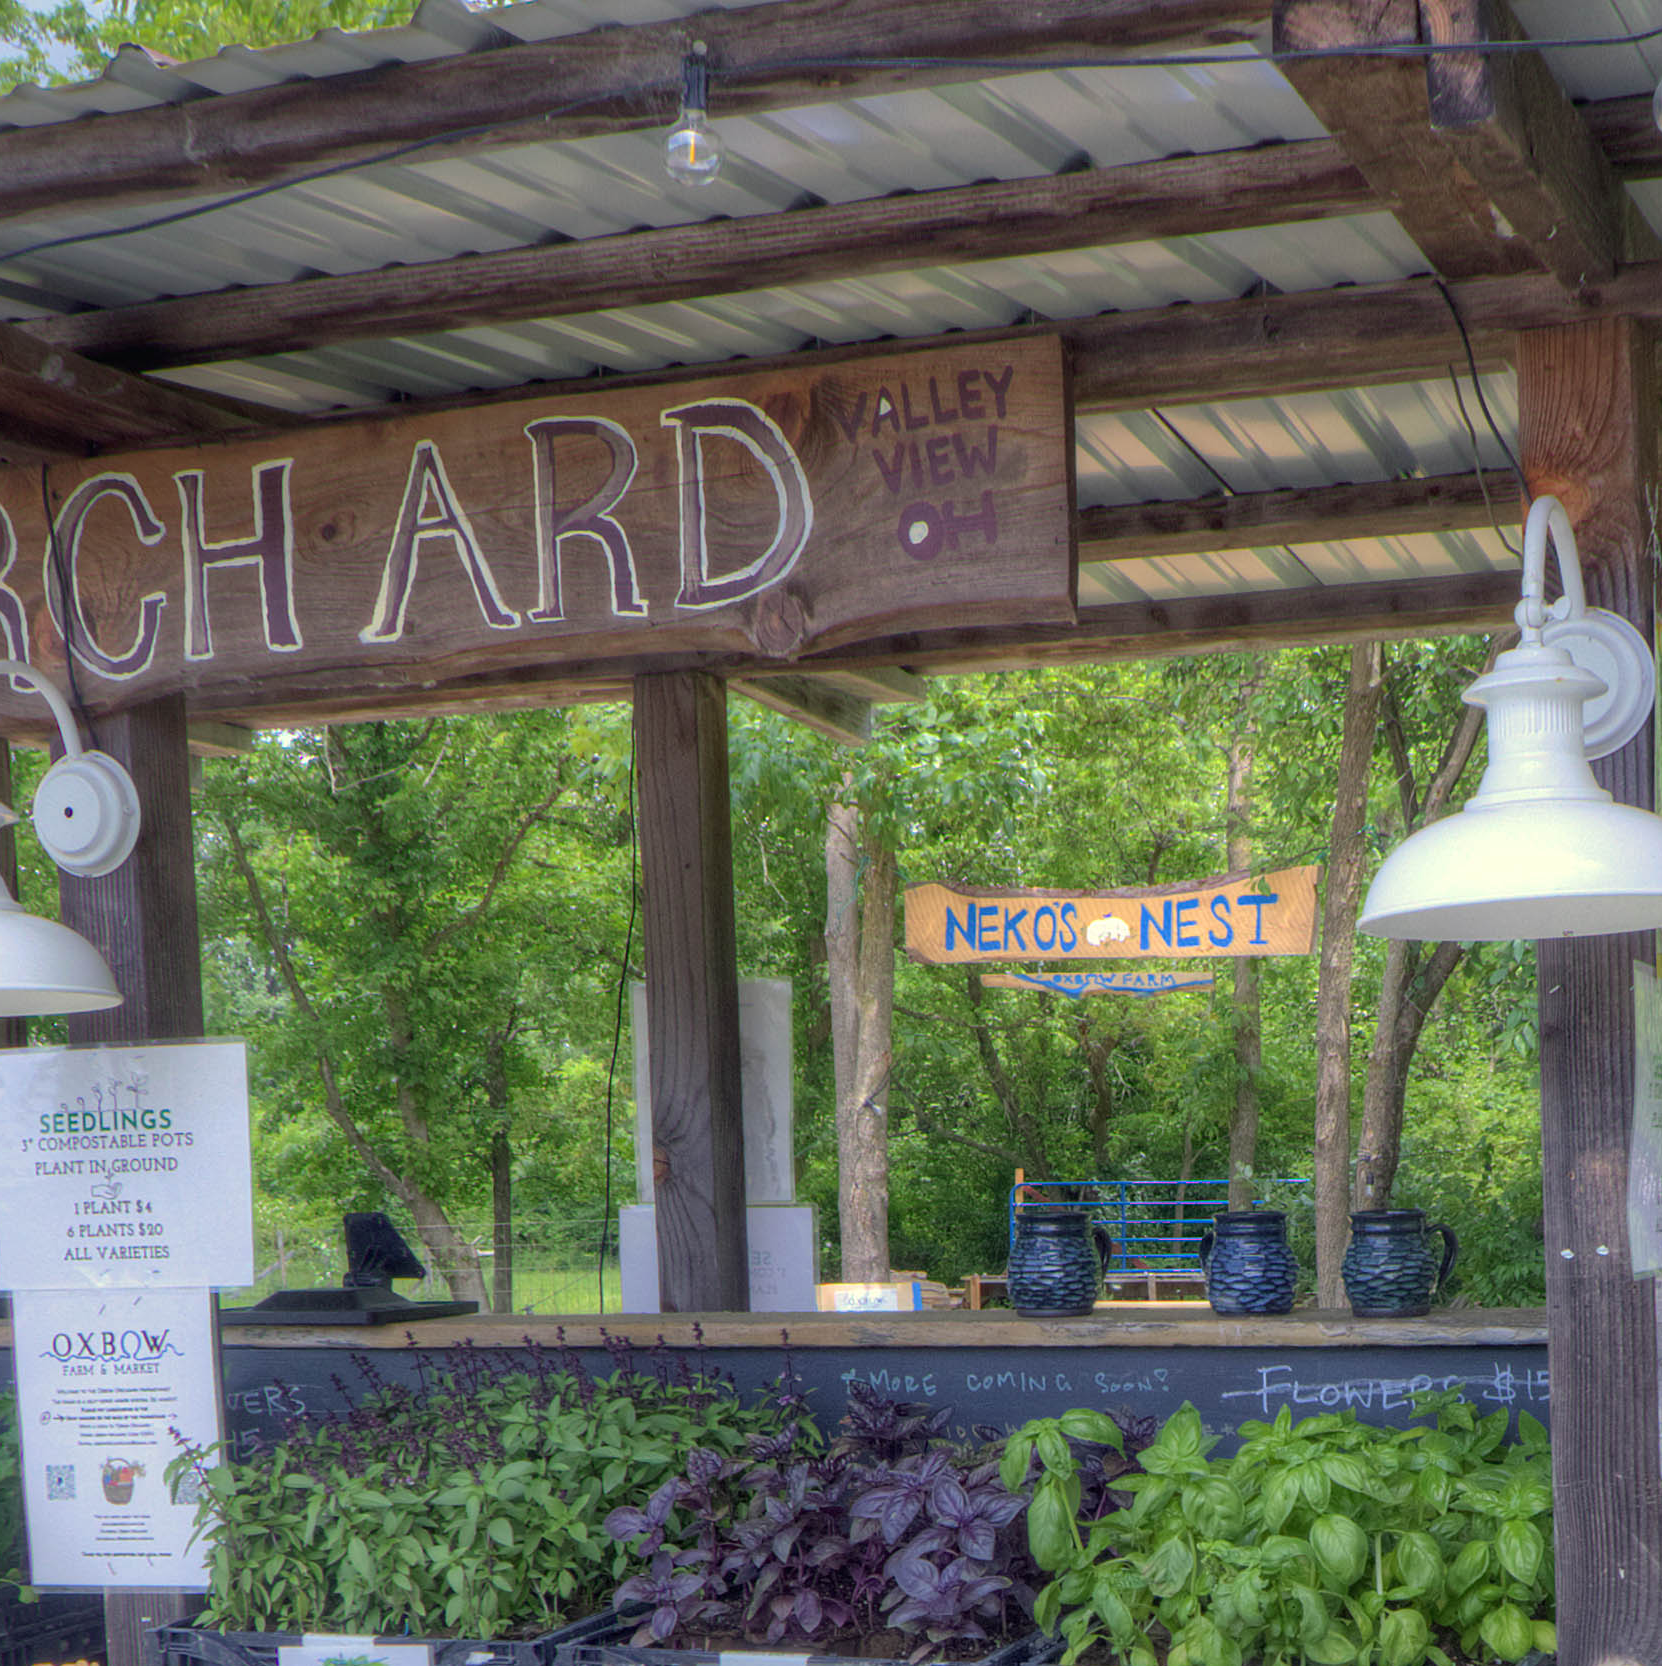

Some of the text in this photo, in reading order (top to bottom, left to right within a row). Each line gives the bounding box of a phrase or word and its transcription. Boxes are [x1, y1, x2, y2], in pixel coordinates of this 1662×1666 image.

[838, 365, 1014, 443] VALLEY
[872, 424, 998, 494] VIEW
[897, 490, 998, 561] OH
[944, 893, 1279, 954] NEKO'S NEST
[1123, 972, 1175, 986] FARM
[40, 1108, 172, 1134] SEEDLINGS
[37, 1134, 147, 1151] COMPOSTABLE
[152, 1132, 194, 1147] POTS
[35, 1157, 179, 1176] PLANT IN GROUND
[83, 1200, 131, 1215] PLANT
[79, 1224, 135, 1238] PLANTS
[138, 1223, 164, 1237] $20
[64, 1246, 171, 1261] ALL VARIETIES
[62, 1364, 94, 1376] FARM
[113, 1362, 161, 1375] MARKET
[869, 1368, 937, 1397] MORE
[967, 1371, 1073, 1393] COMING
